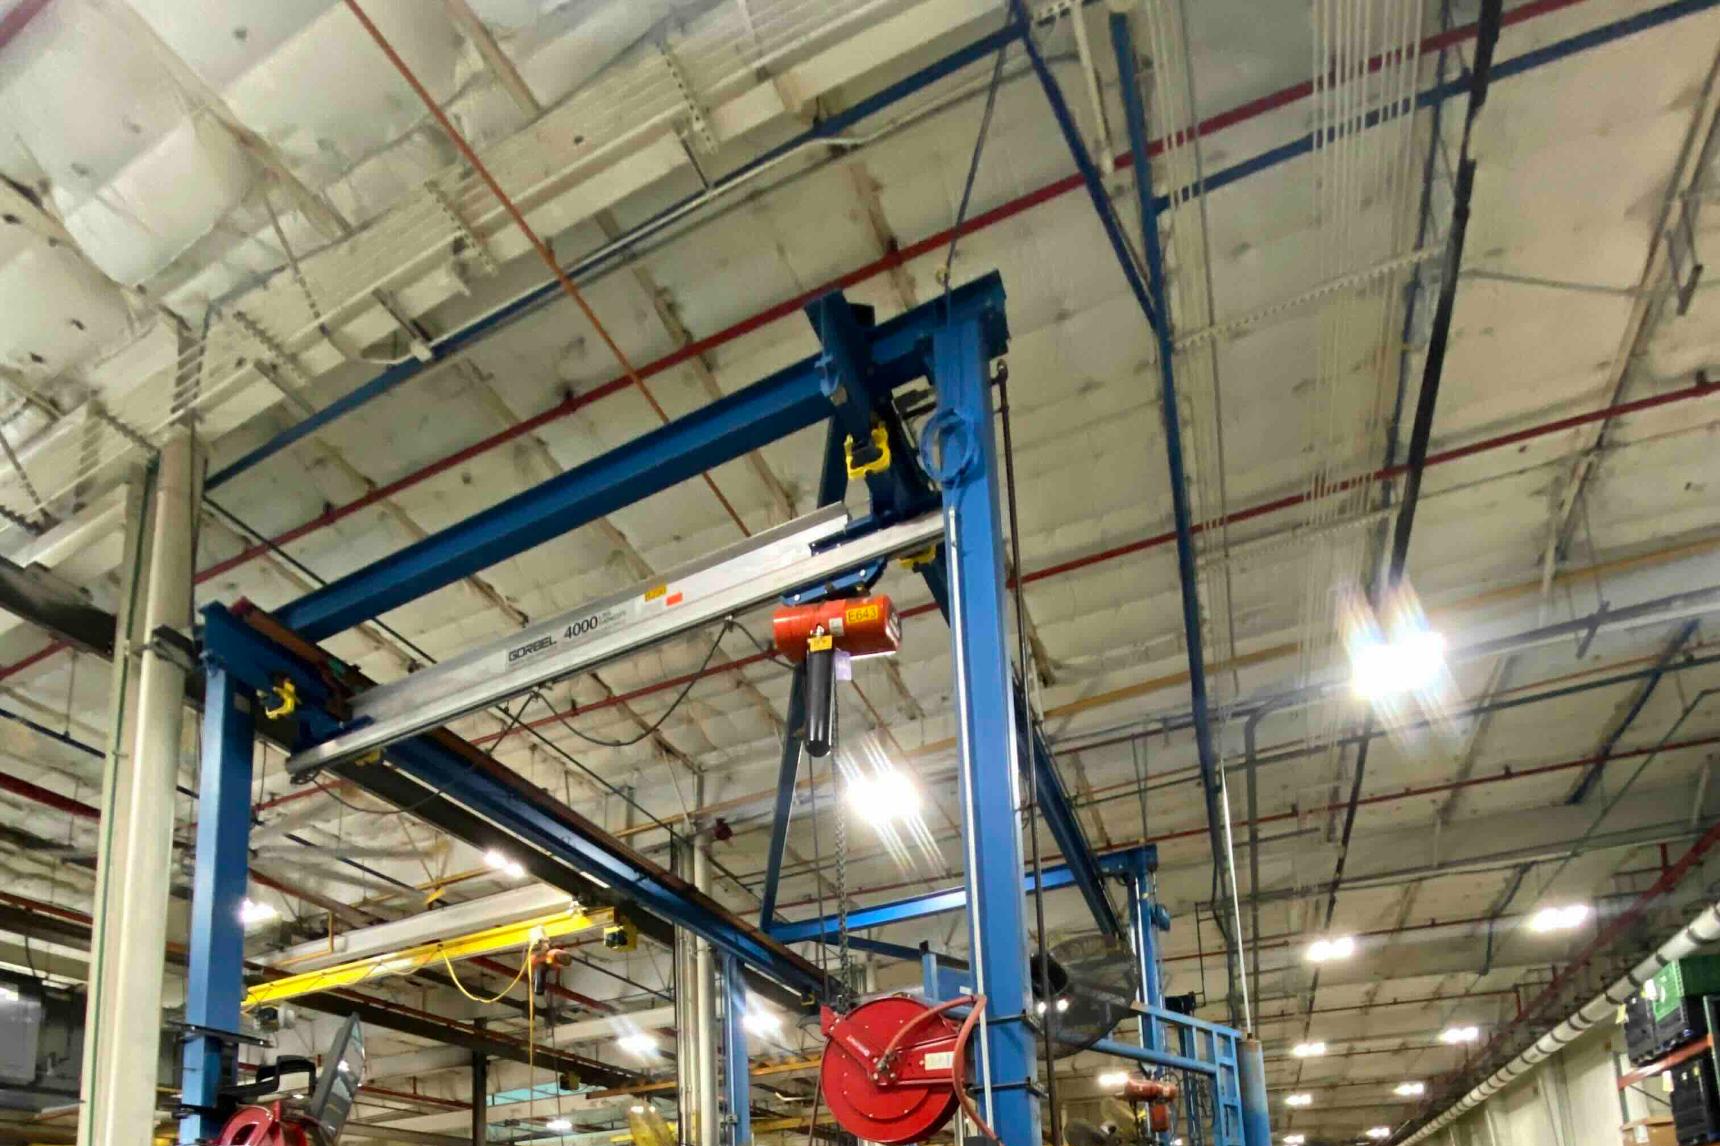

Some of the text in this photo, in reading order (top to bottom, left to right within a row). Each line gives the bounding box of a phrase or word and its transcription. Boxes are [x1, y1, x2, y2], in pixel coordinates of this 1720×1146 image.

[848, 606, 877, 623] E643
[508, 636, 557, 662] GORBEL
[564, 615, 598, 639] 4000
